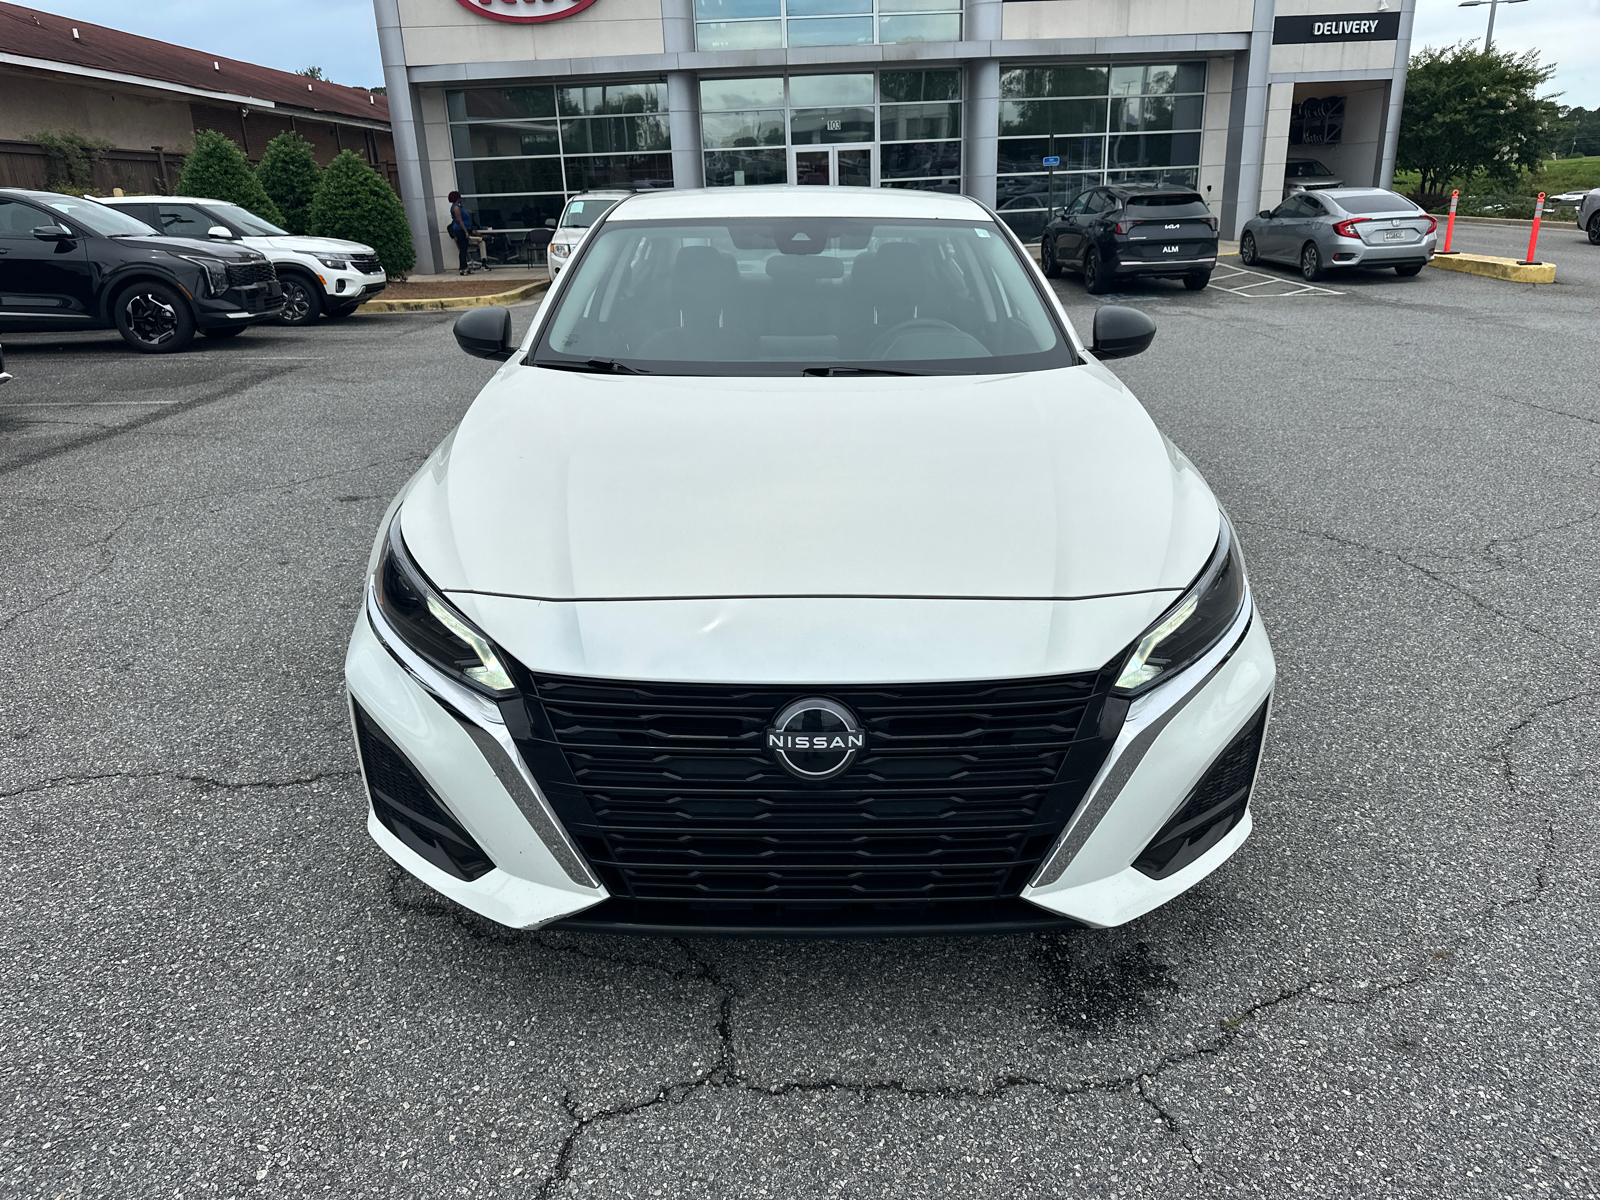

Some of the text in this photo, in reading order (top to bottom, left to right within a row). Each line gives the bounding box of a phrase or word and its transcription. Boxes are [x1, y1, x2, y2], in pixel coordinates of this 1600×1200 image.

[1313, 19, 1379, 35] DELIVERY
[828, 120, 841, 130] 103
[769, 735, 863, 749] NISSAN
